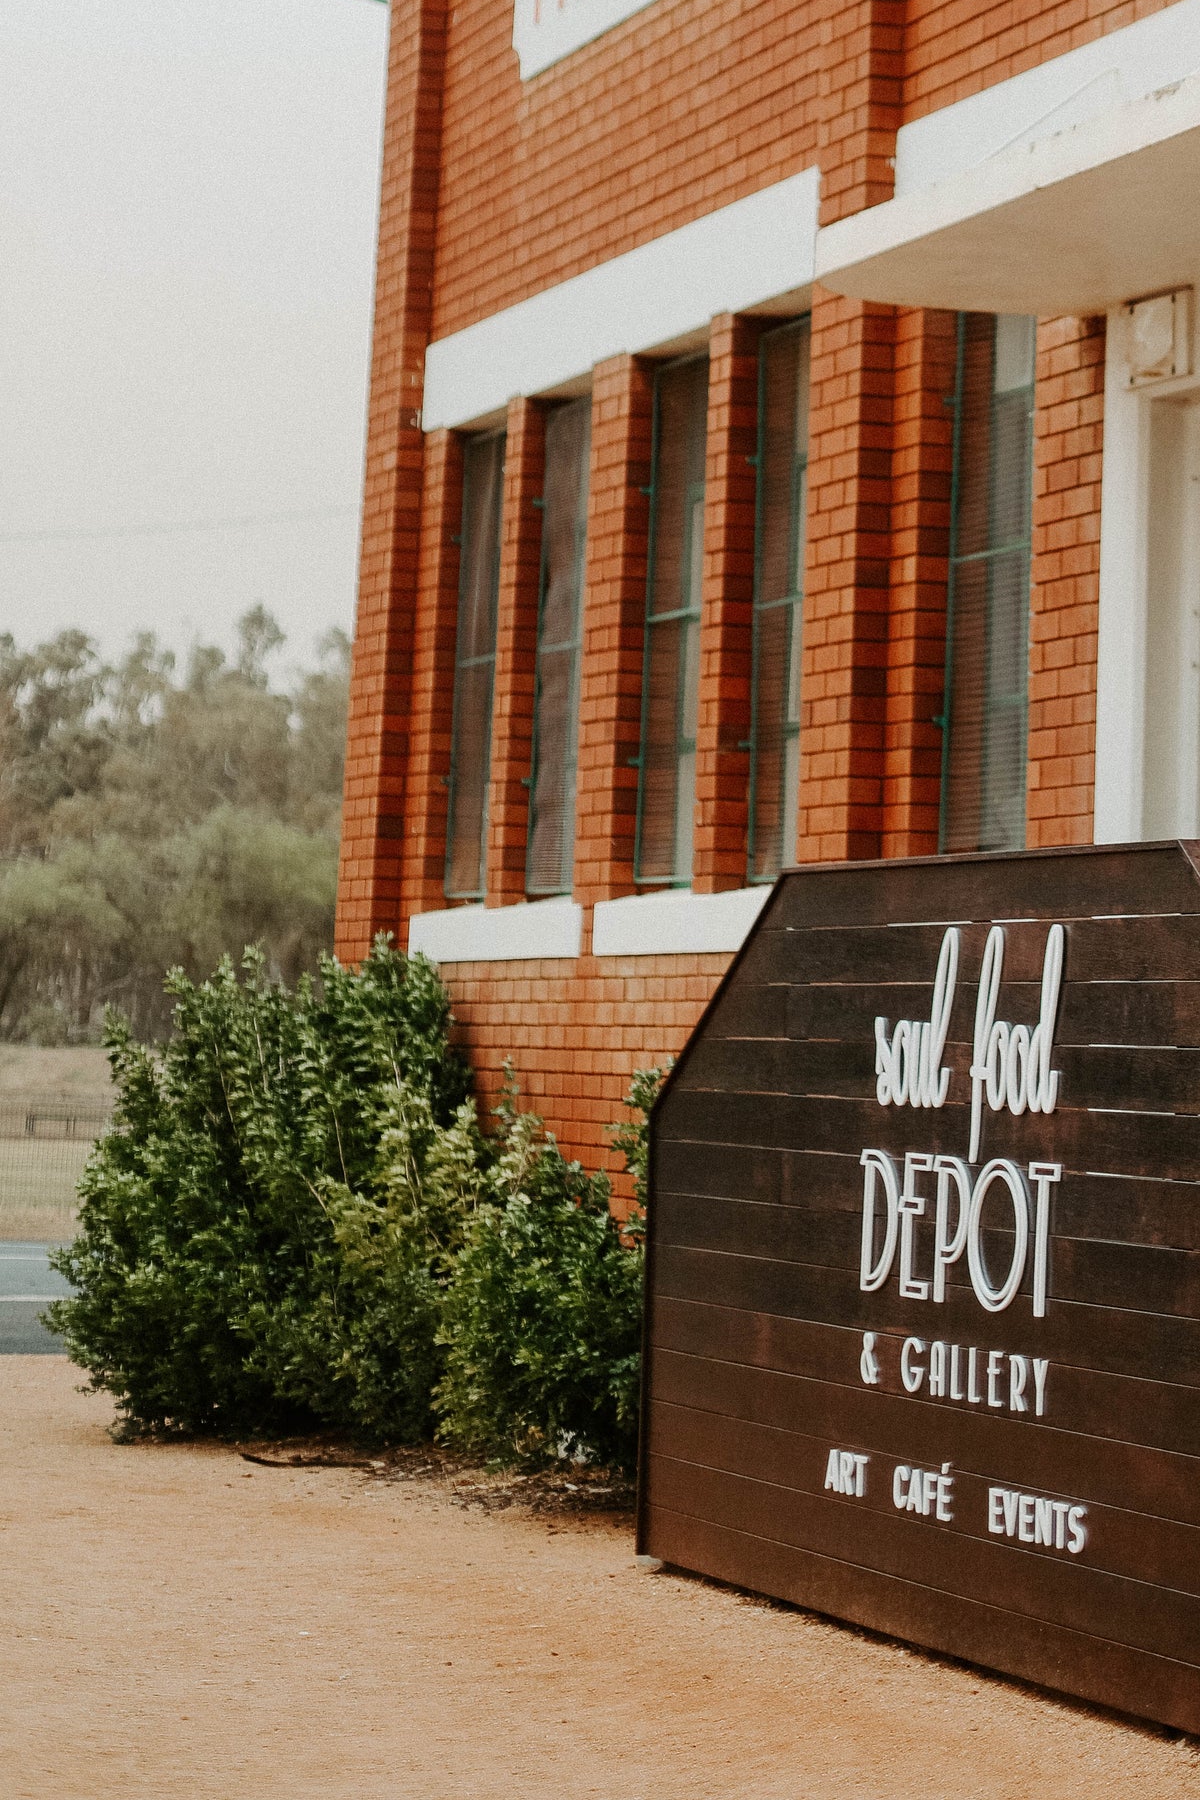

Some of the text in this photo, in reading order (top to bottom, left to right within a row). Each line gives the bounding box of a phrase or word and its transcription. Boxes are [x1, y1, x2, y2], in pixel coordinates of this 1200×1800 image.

[875, 924, 1063, 1163] soul food
[860, 1149, 1062, 1317] DEPOT
[860, 1332, 1049, 1416] & GALLERY
[824, 1449, 1087, 1554] ART CAFÉ EVENTS
